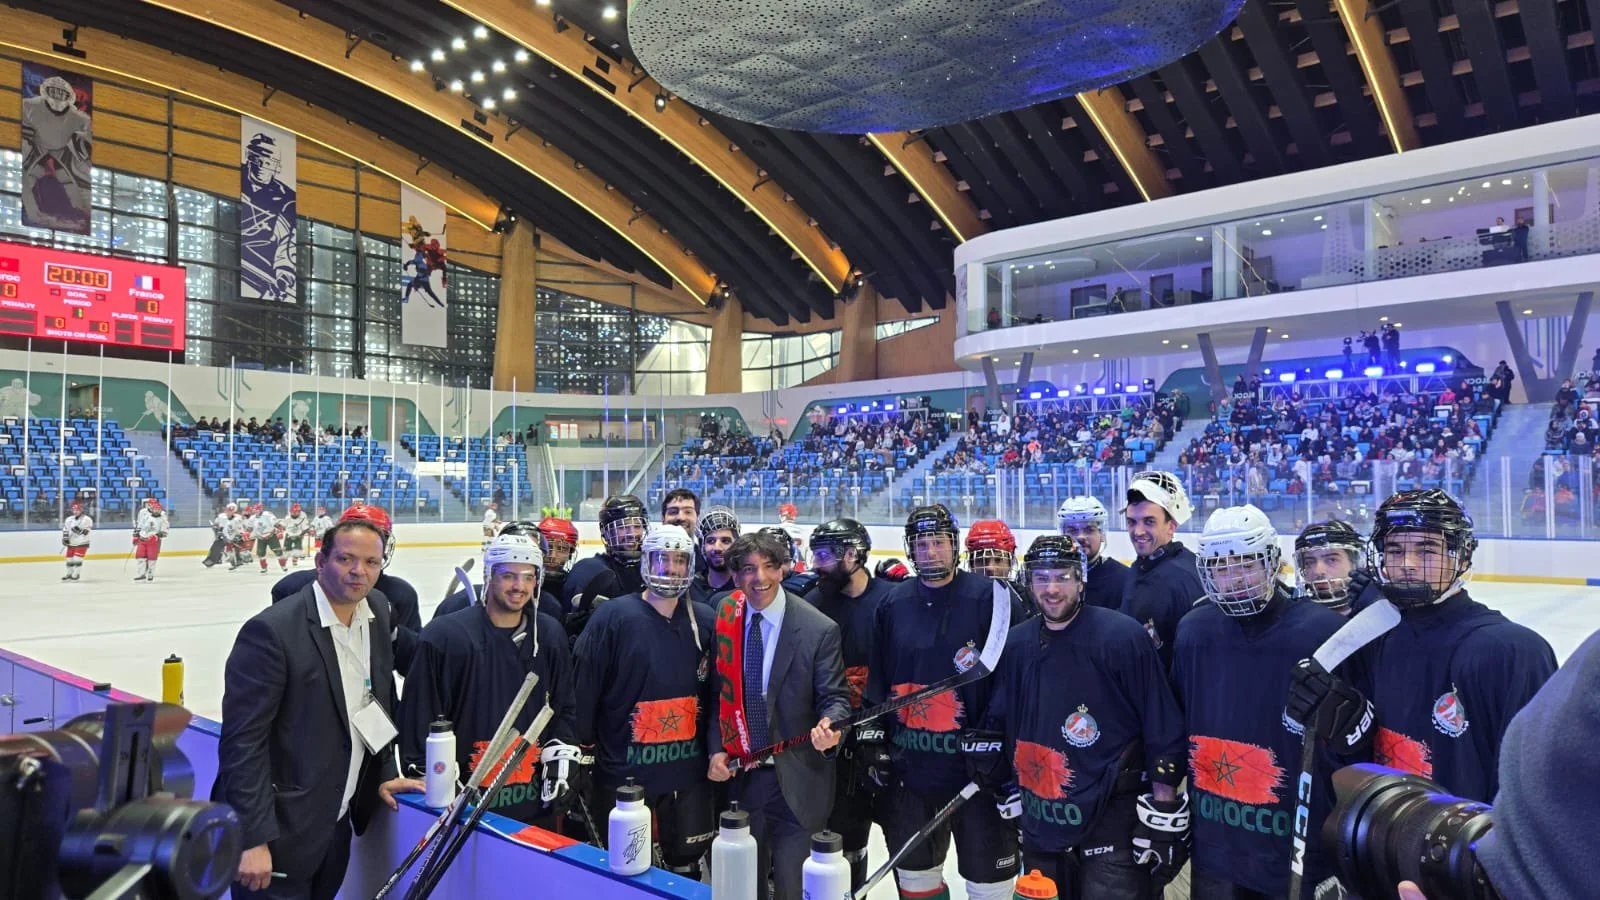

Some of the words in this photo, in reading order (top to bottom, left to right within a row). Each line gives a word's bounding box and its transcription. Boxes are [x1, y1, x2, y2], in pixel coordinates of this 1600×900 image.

[49, 266, 108, 288] 20:00
[5, 283, 17, 297] 0
[66, 290, 88, 298] GOAL
[128, 288, 164, 300] France
[1, 300, 36, 309] PENALTY
[63, 299, 92, 307] PERIOD
[147, 300, 158, 313] 0
[111, 312, 138, 320] PLAYER
[143, 316, 173, 324] PENALTY
[55, 317, 64, 328] 0
[99, 322, 109, 333] 0
[46, 329, 73, 337] SHOTS
[1291, 771, 1312, 876] CCM
[1084, 846, 1114, 856] CCM
